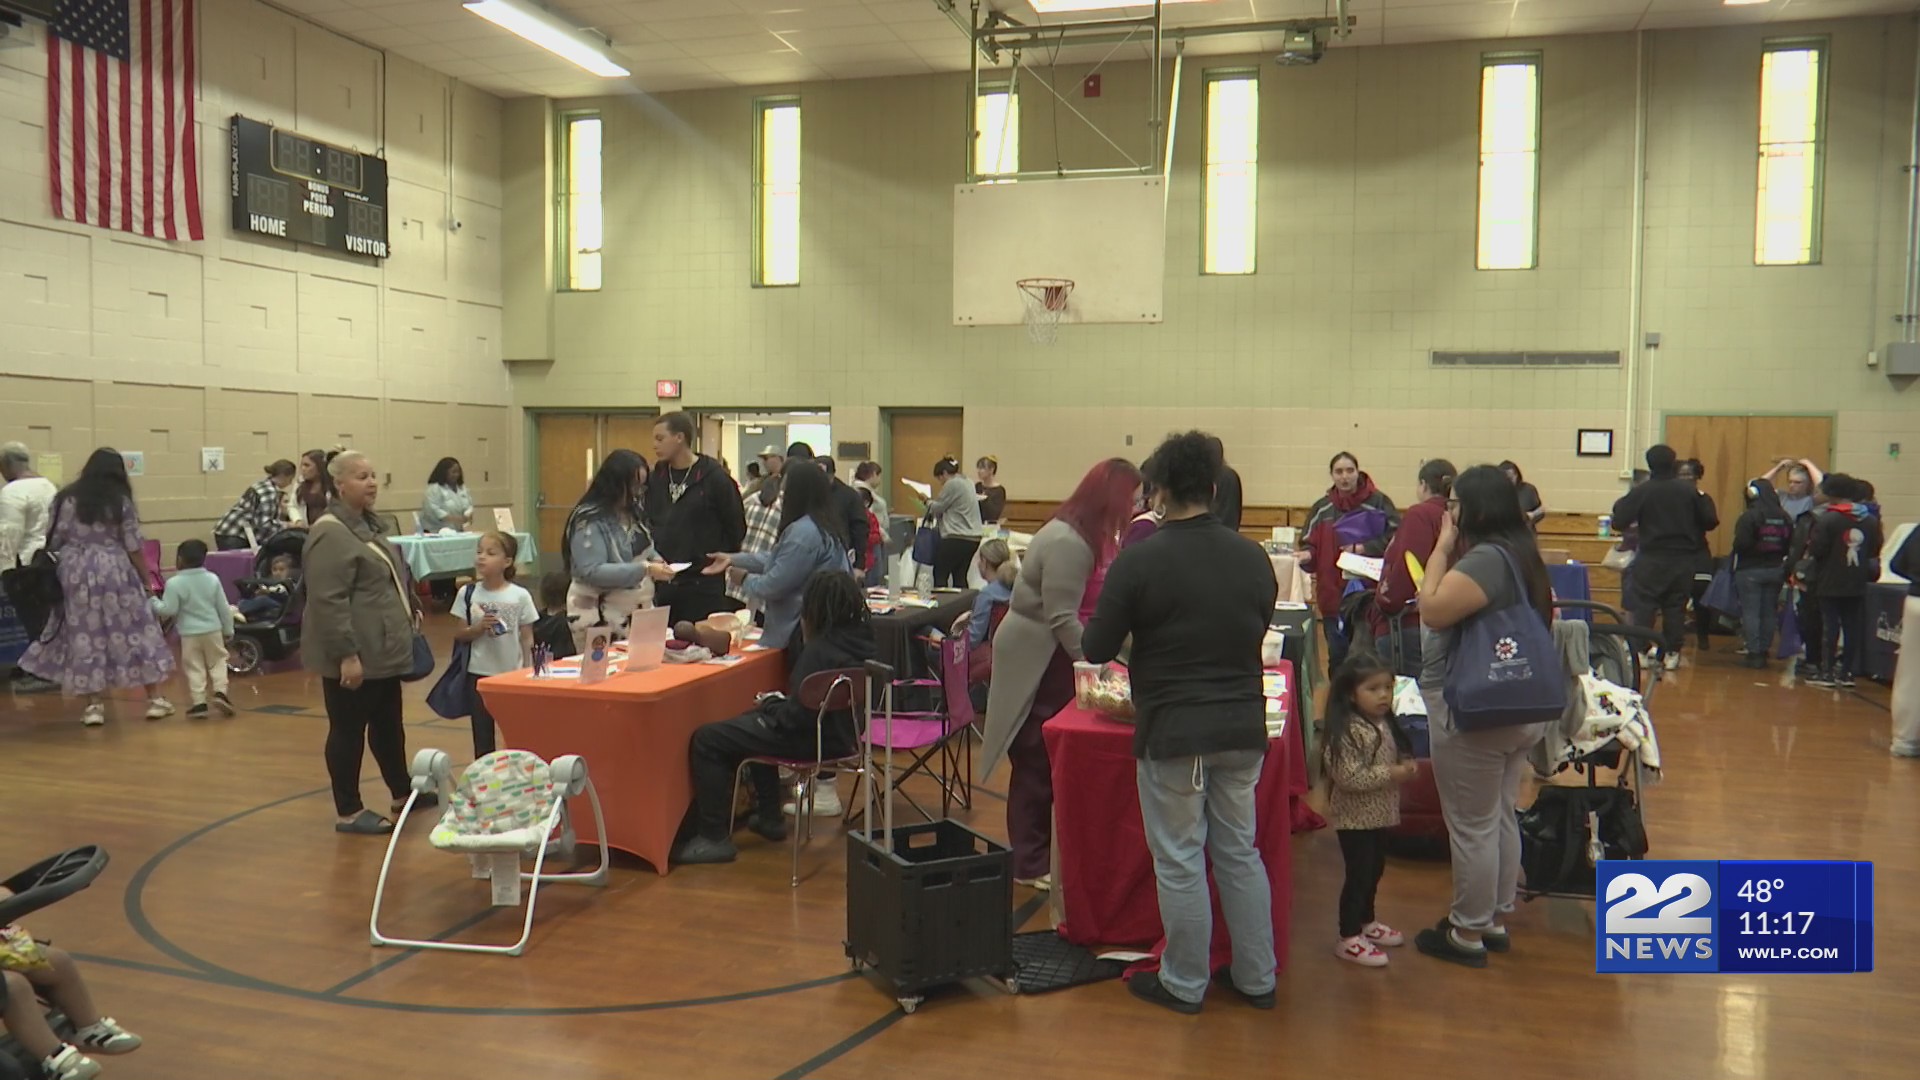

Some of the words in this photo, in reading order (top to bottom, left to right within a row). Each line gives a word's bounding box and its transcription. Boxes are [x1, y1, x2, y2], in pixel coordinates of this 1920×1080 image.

[307, 181, 330, 196] BONUS
[310, 191, 328, 204] POSS
[303, 199, 335, 218] PERIOD
[249, 213, 287, 237] HOME
[345, 233, 387, 258] VISITOR
